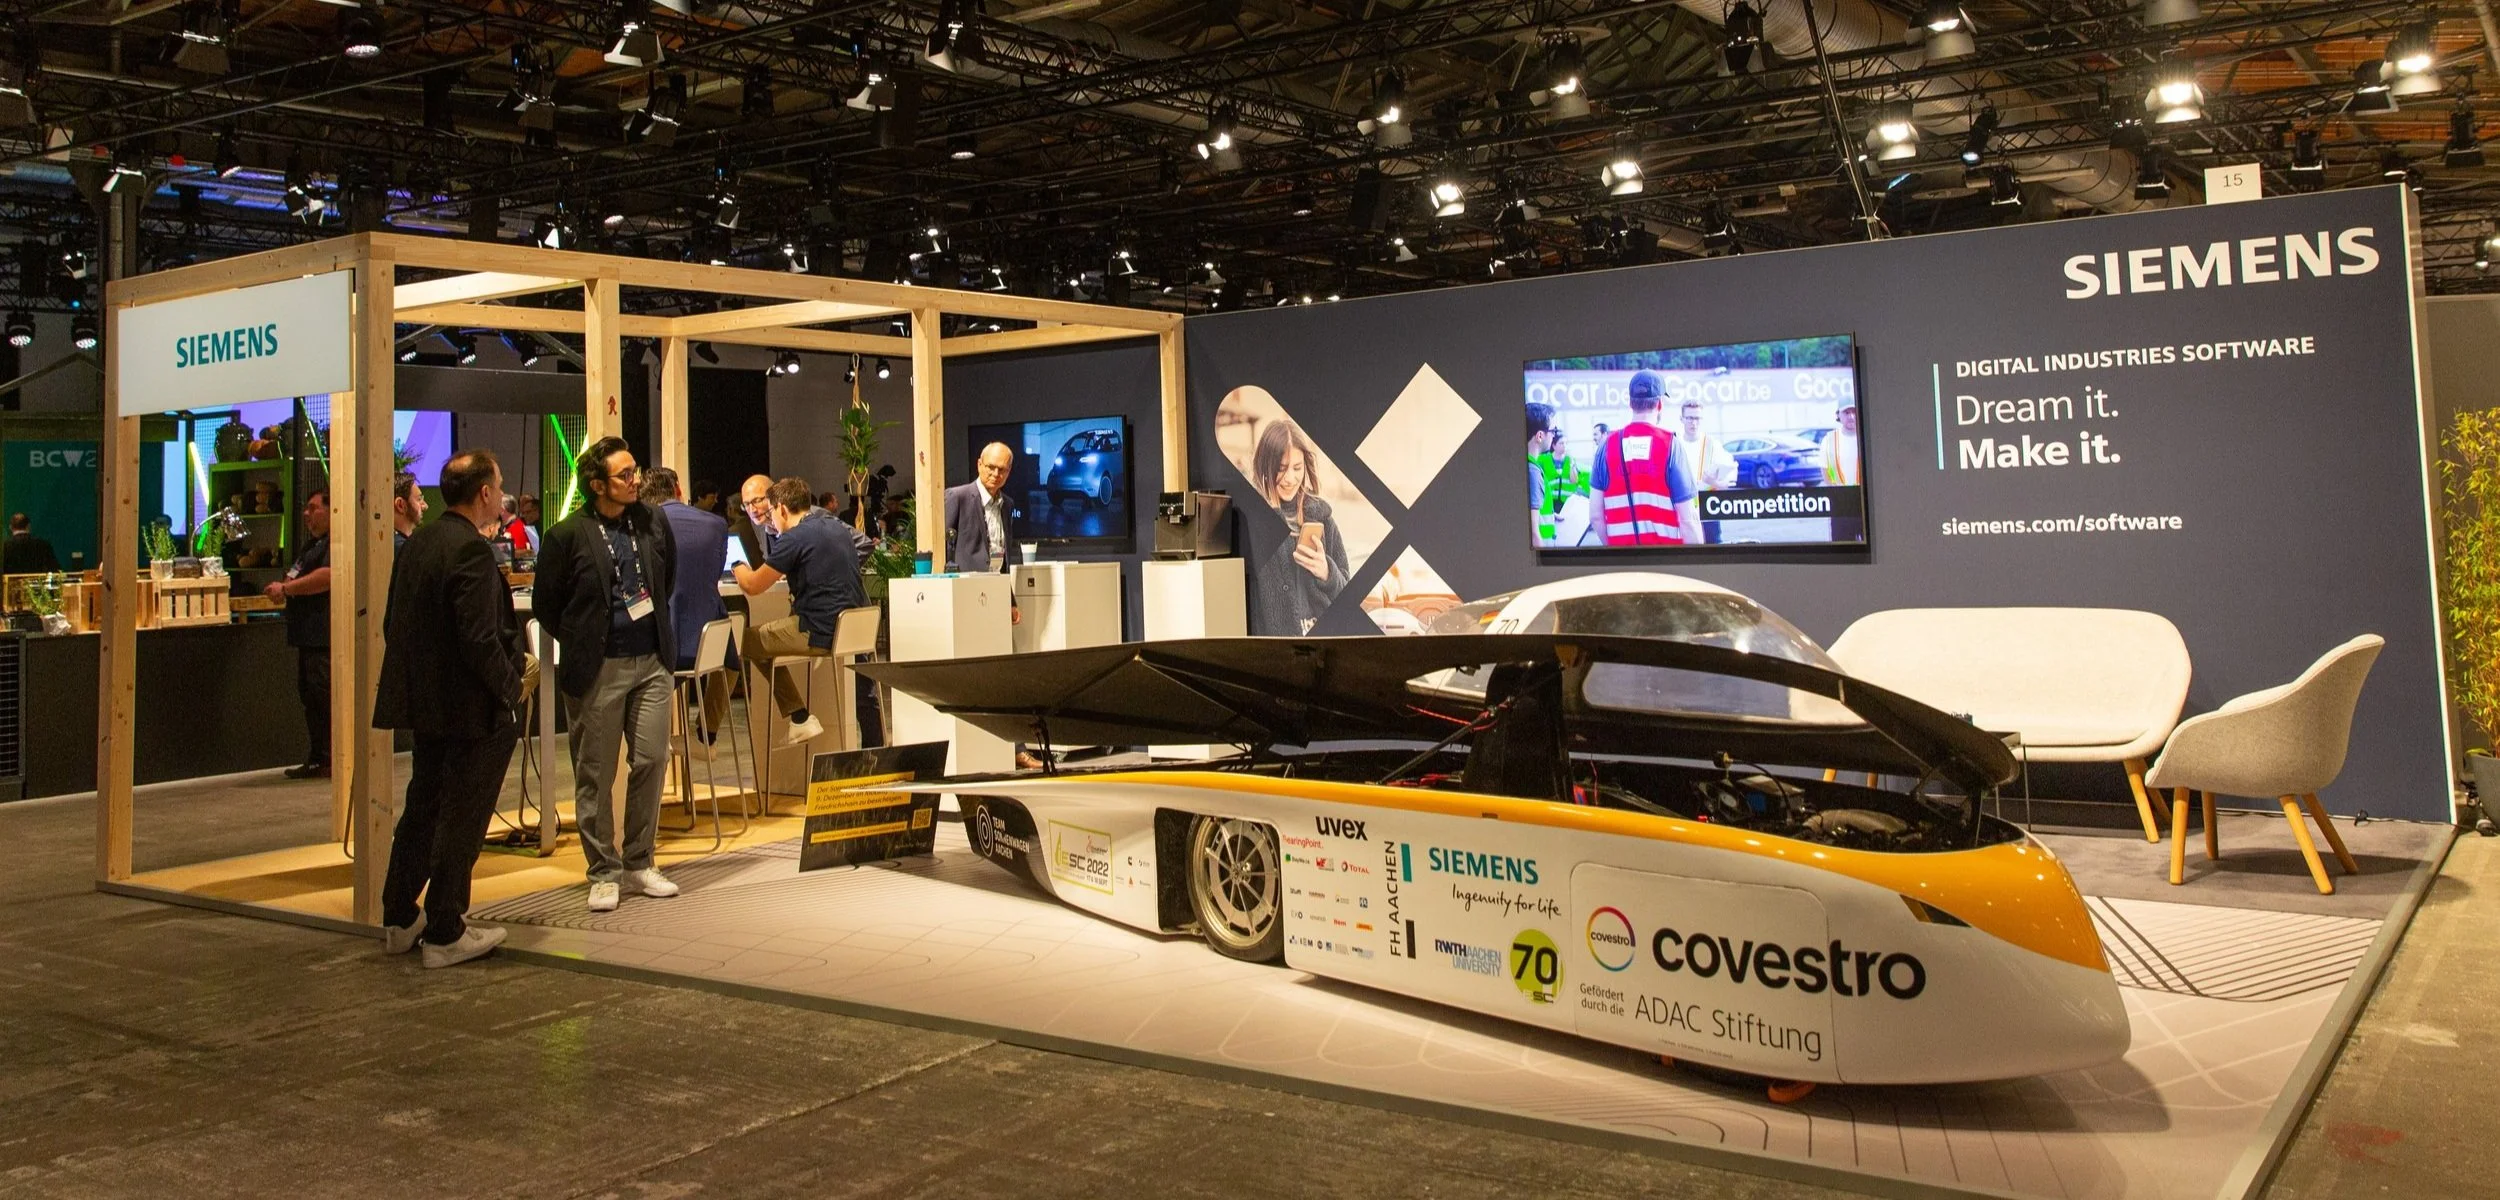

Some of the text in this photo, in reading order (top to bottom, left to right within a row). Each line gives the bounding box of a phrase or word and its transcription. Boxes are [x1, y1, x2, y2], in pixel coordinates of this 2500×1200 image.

[2223, 173, 2243, 188] 15
[2063, 227, 2380, 300] SIEMENS
[176, 323, 278, 369] SIEMENS
[1955, 336, 2315, 378] DIGITAL INDUSTRIES SOFTWARE
[1664, 375, 1772, 403] Gocar.be
[1956, 385, 2119, 426] Dream it.
[1958, 431, 2121, 470] Make it.
[1706, 492, 1831, 519] Competition
[1941, 513, 2183, 536] siemens.com/software
[992, 816, 1006, 831] TEAM
[1315, 815, 1368, 841] uvex
[1086, 858, 1109, 878] 2022
[1349, 864, 1370, 874] TOTAL
[1429, 847, 1539, 885] SIEMENS
[1384, 840, 1402, 958] FH AACHEN
[1452, 883, 1562, 920] Ingenuity for life
[1590, 931, 1630, 946] covestro
[1453, 955, 1501, 977] UNIVERSITY
[1513, 942, 1558, 986] 70
[1652, 927, 1927, 1001] covestro
[1580, 983, 1624, 1002] Gefördert
[1581, 997, 1625, 1017] durch die
[1635, 994, 1702, 1033] ADAC
[1712, 1009, 1821, 1062] Stiftung
